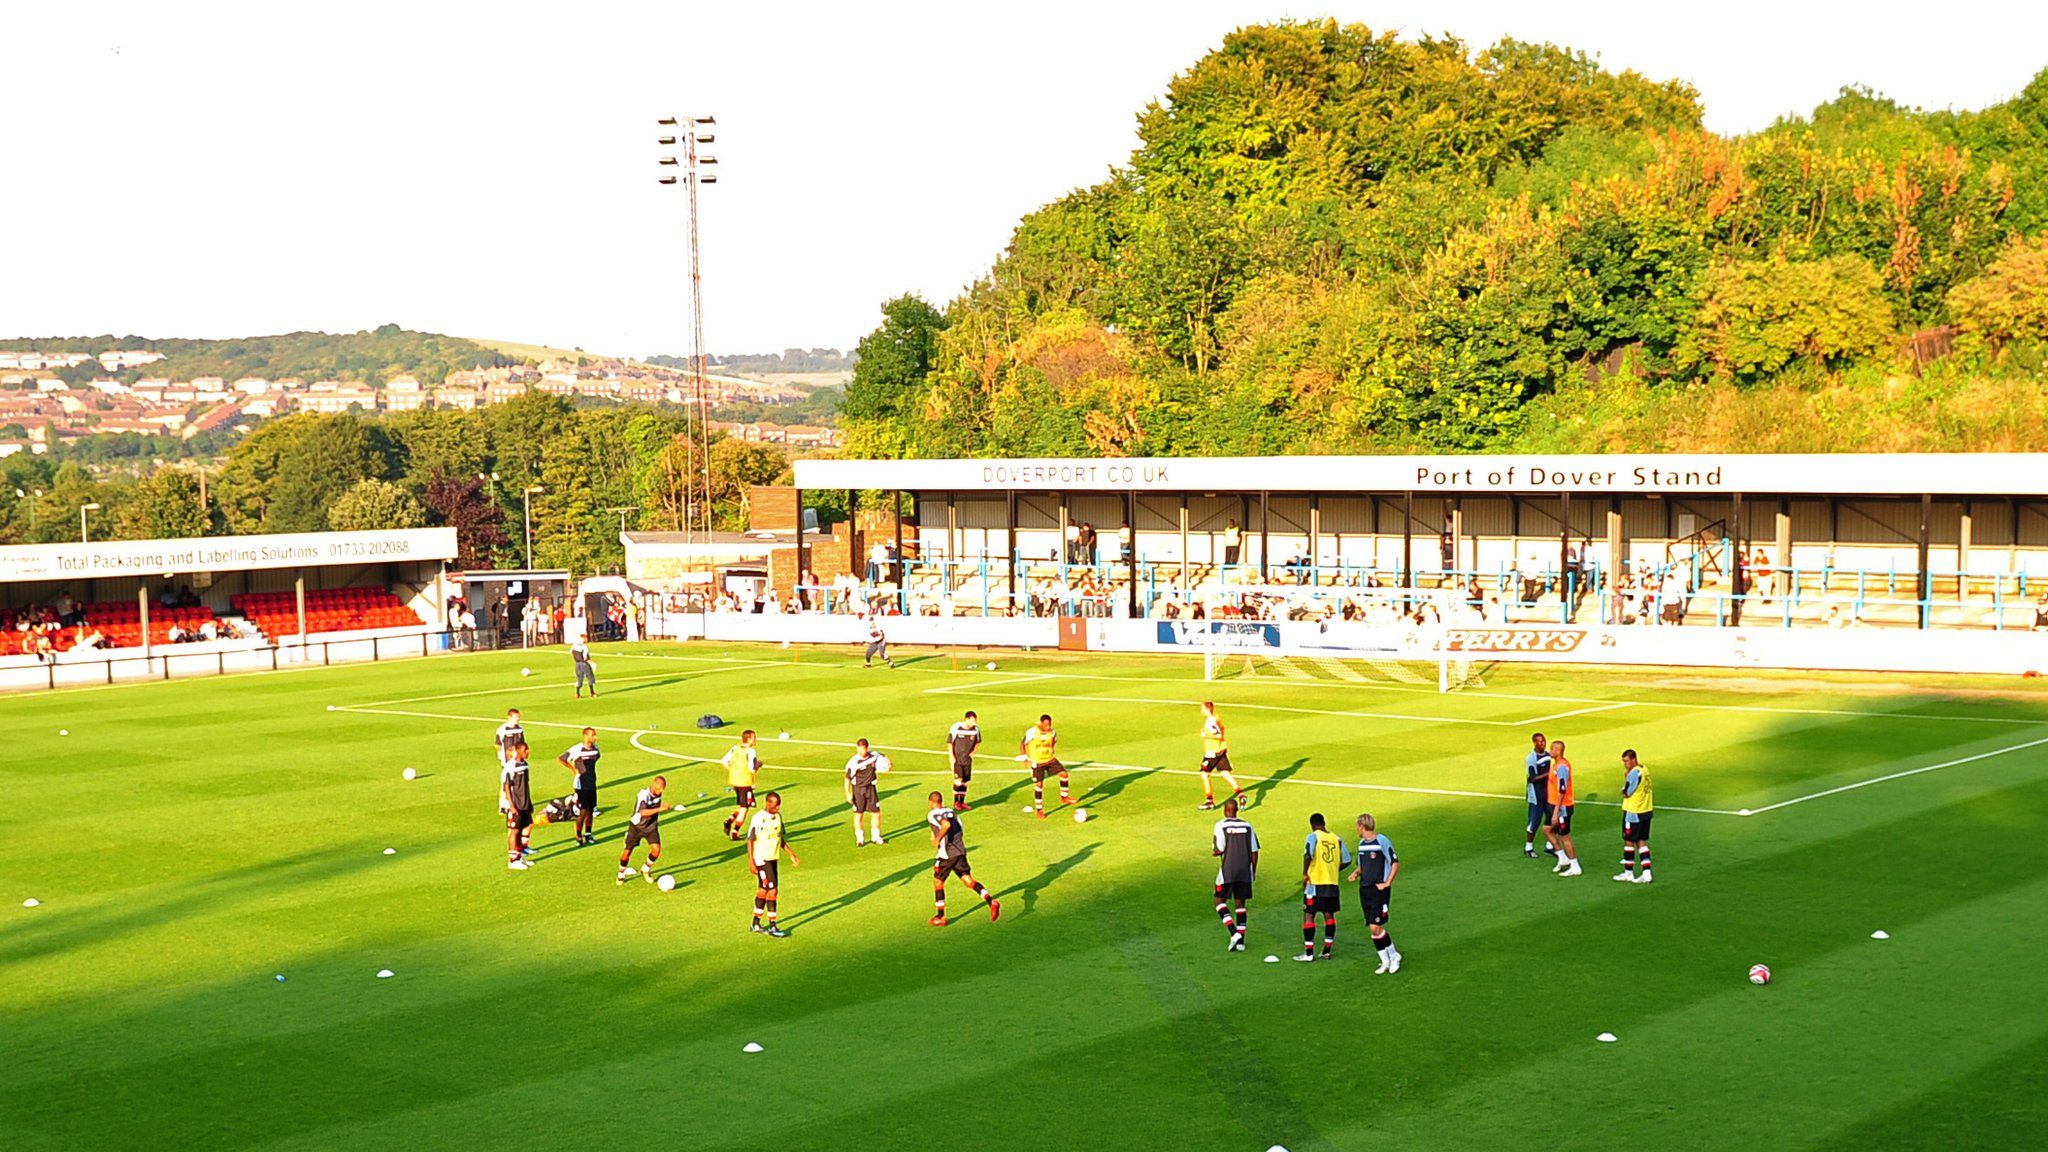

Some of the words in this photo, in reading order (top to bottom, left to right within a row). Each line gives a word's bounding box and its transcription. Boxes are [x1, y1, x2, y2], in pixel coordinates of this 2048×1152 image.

[1416, 467, 1473, 486] Port
[1488, 466, 1516, 486] of
[1530, 467, 1617, 486] Dover
[1633, 466, 1721, 486] Stand
[57, 555, 89, 571] Total
[93, 553, 163, 569] Packaging
[168, 551, 193, 565] and
[199, 548, 257, 562] Labelling
[261, 546, 319, 560] Solutions
[329, 543, 365, 557] 01733
[1447, 630, 1580, 651] PERRYS
